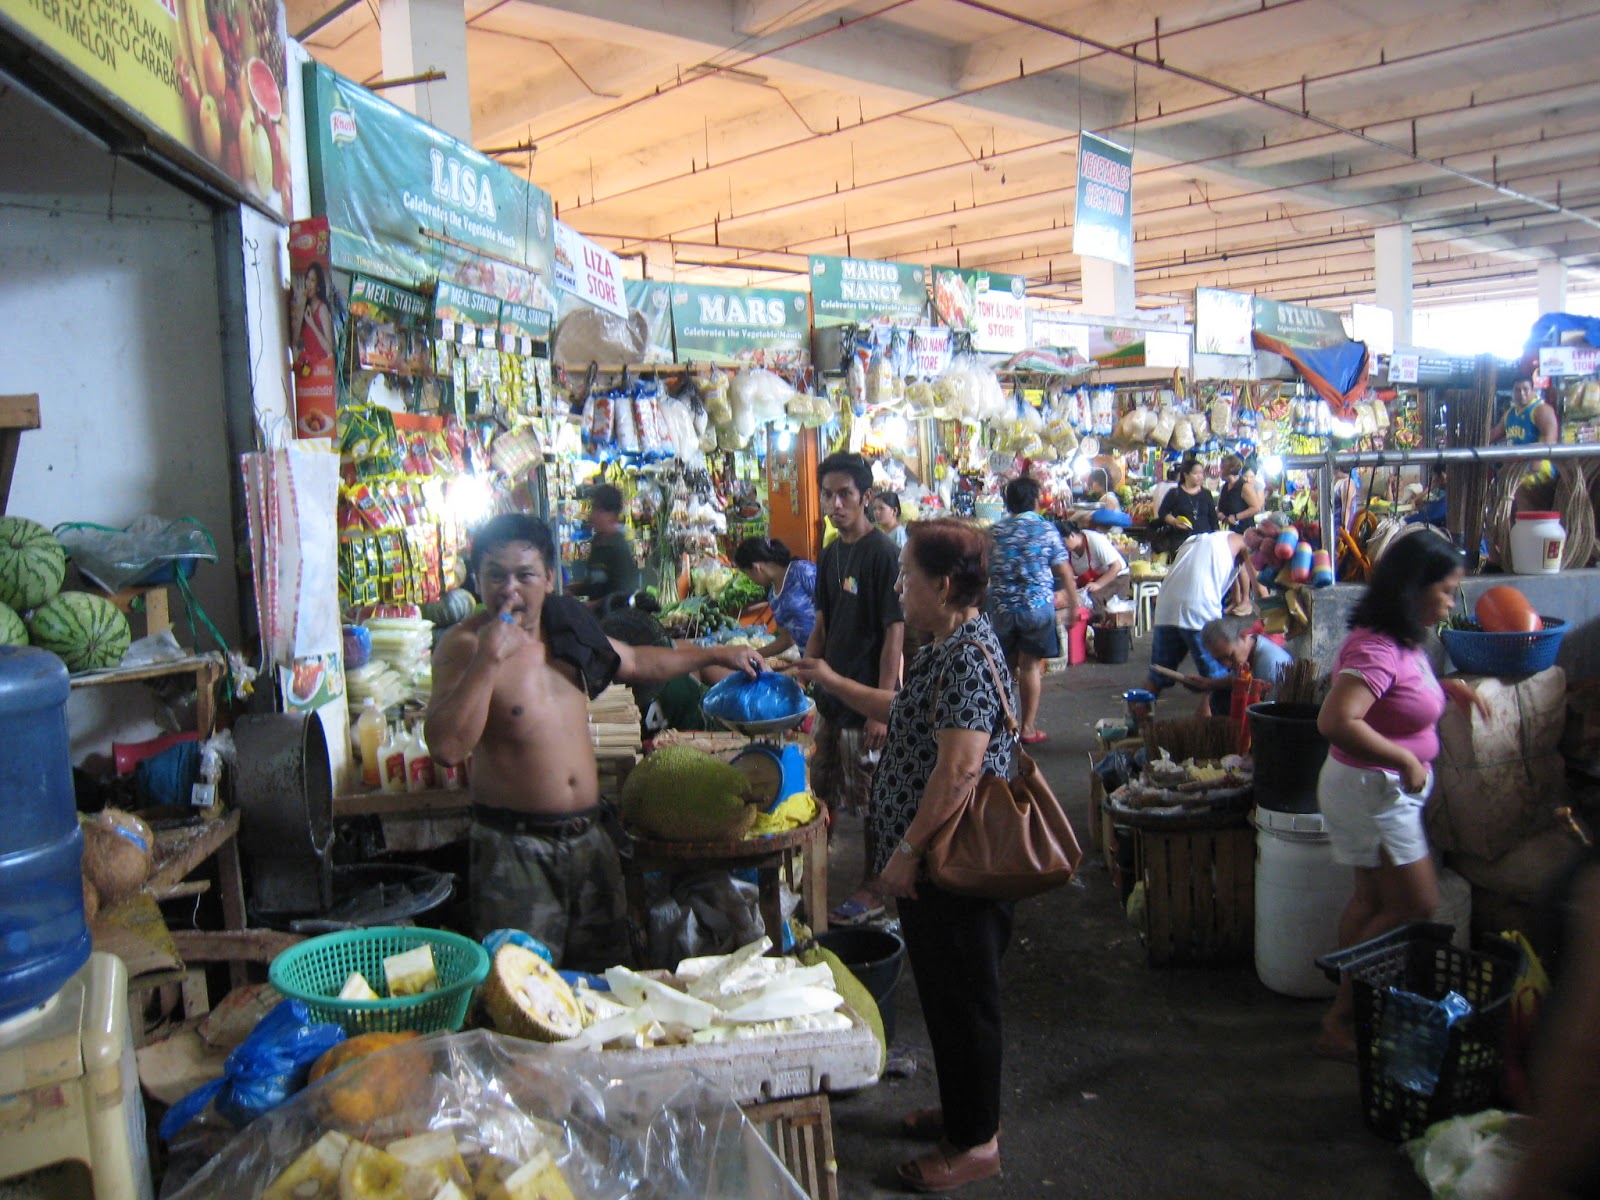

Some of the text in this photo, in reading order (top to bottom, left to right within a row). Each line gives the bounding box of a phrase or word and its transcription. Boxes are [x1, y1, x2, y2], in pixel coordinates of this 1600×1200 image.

[65, 7, 117, 70] MELON
[87, 0, 184, 96] CHICO CARABAO
[430, 147, 497, 223] LISA
[1081, 149, 1131, 193] VEGETABLES
[1084, 181, 1126, 216] SECTION
[403, 191, 516, 248] Celebrates the Vegetable Month
[583, 243, 614, 280] LIZA
[841, 259, 899, 283] MARIO
[365, 281, 391, 307] MEAL
[393, 292, 427, 317] STATION
[450, 286, 500, 316] MEAL STATION
[587, 272, 618, 306] STORE
[821, 299, 857, 309] Celebrates
[858, 300, 870, 310] the
[840, 280, 903, 301] NANCY
[512, 304, 550, 327] MEAL STATION
[698, 293, 786, 326] MARS
[978, 300, 994, 318] TONY
[996, 301, 1001, 319] &
[1278, 303, 1326, 328] SYLVIA
[684, 326, 803, 341] Celebrates the Vegetable Month
[988, 322, 1015, 337] STORE
[1573, 361, 1597, 371] STORE
